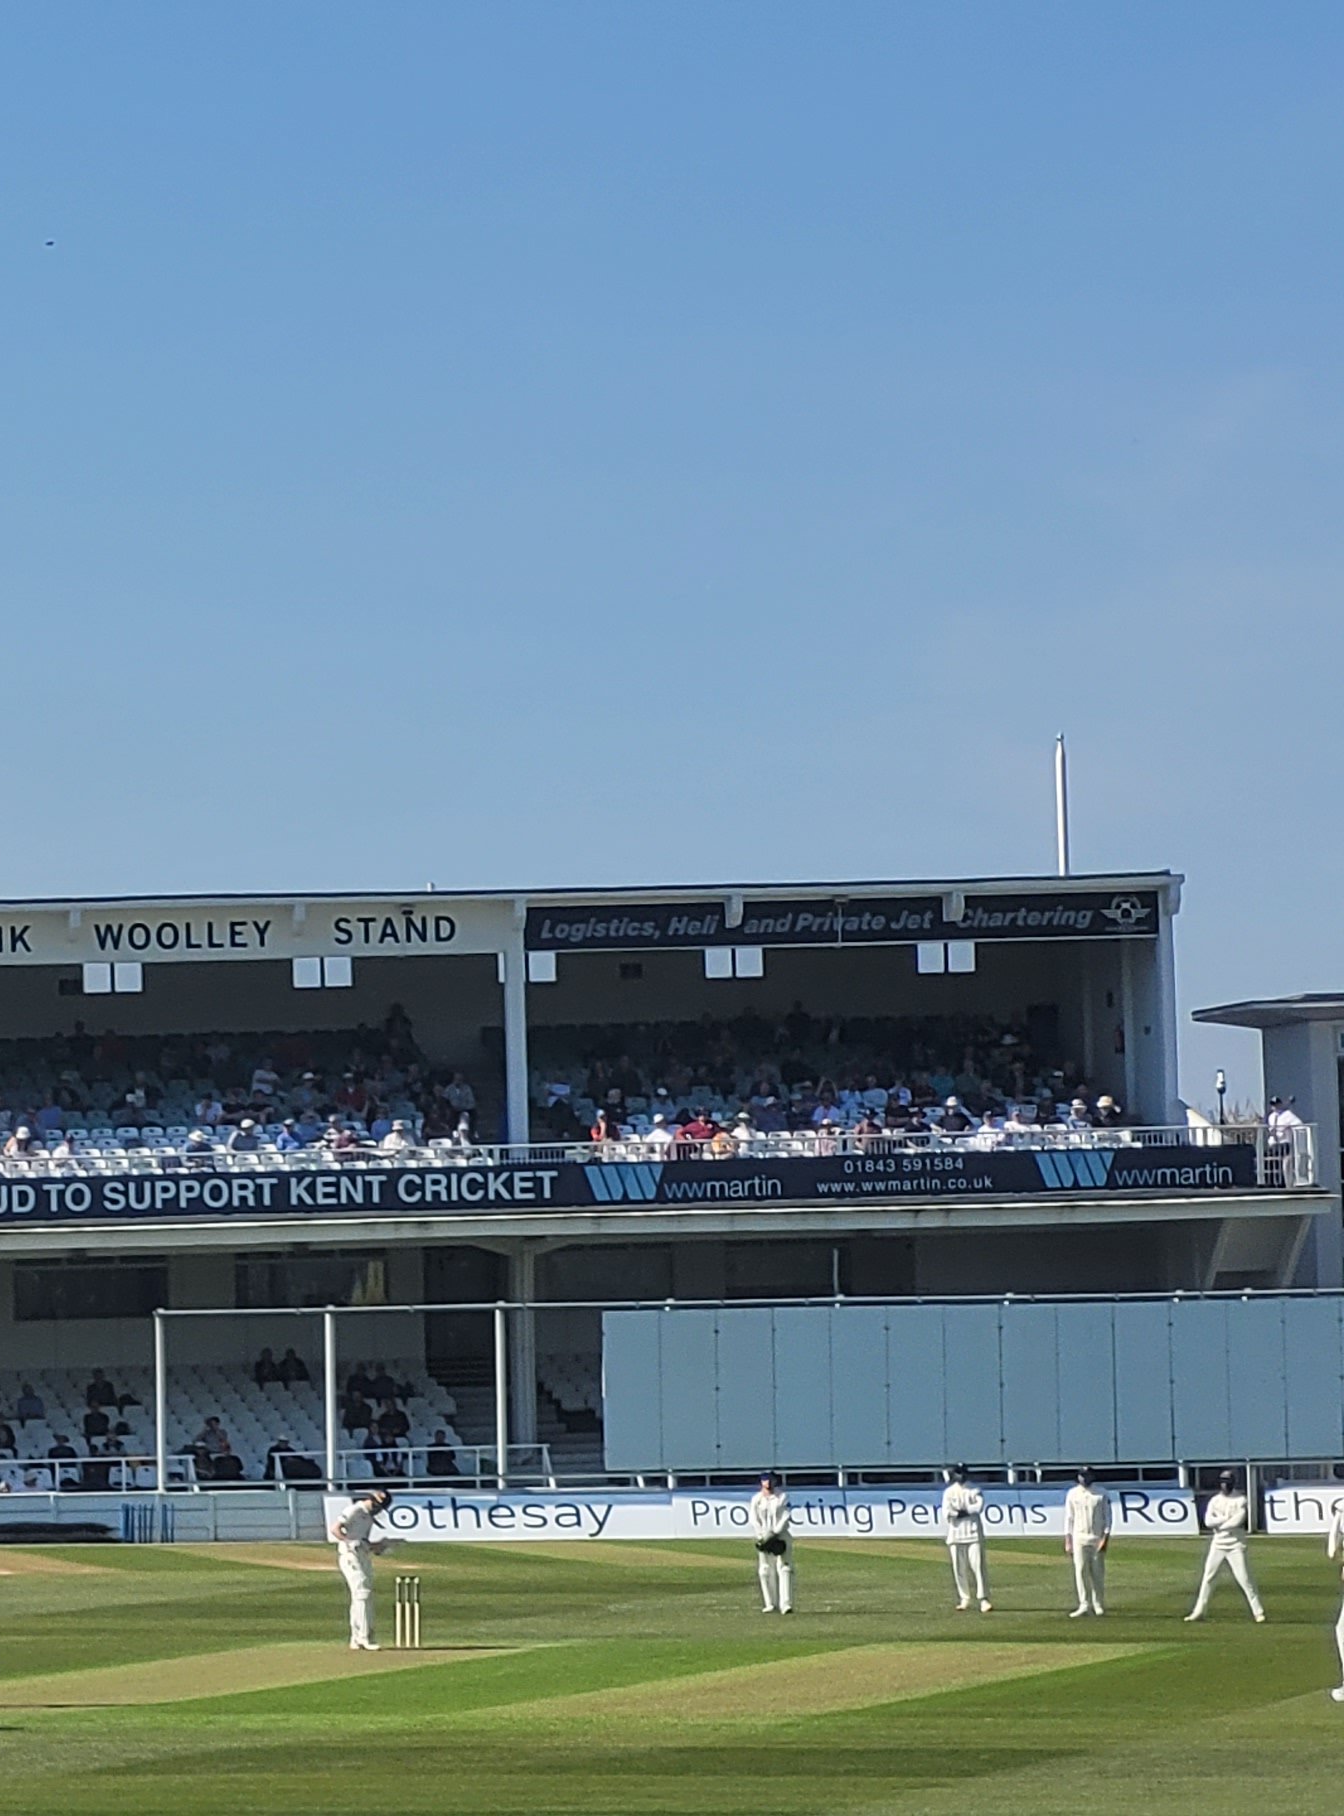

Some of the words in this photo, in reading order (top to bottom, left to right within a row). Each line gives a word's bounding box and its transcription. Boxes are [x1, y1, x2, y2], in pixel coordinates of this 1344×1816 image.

[94, 920, 272, 951] WOOLLEY
[334, 914, 457, 946] STAND
[540, 916, 661, 941] Logistics,
[667, 915, 720, 936] Heli
[743, 912, 792, 935] and
[794, 910, 886, 932] Private
[890, 910, 933, 930] Jet
[957, 906, 1094, 930] Chartering
[844, 1158, 896, 1174] 01843
[902, 1156, 964, 1171] 591584
[1114, 1161, 1232, 1187] wwmartin
[43, 1182, 92, 1213] TO
[103, 1176, 278, 1212] SUPPORT
[289, 1173, 388, 1205] KENT
[397, 1170, 558, 1203] CRICKET
[664, 1174, 782, 1199] wwmartin
[816, 1175, 993, 1193] www.wwmartin.co.uk
[373, 1497, 612, 1536] othesay
[690, 1497, 874, 1534] Procting
[887, 1498, 1047, 1525] Perons
